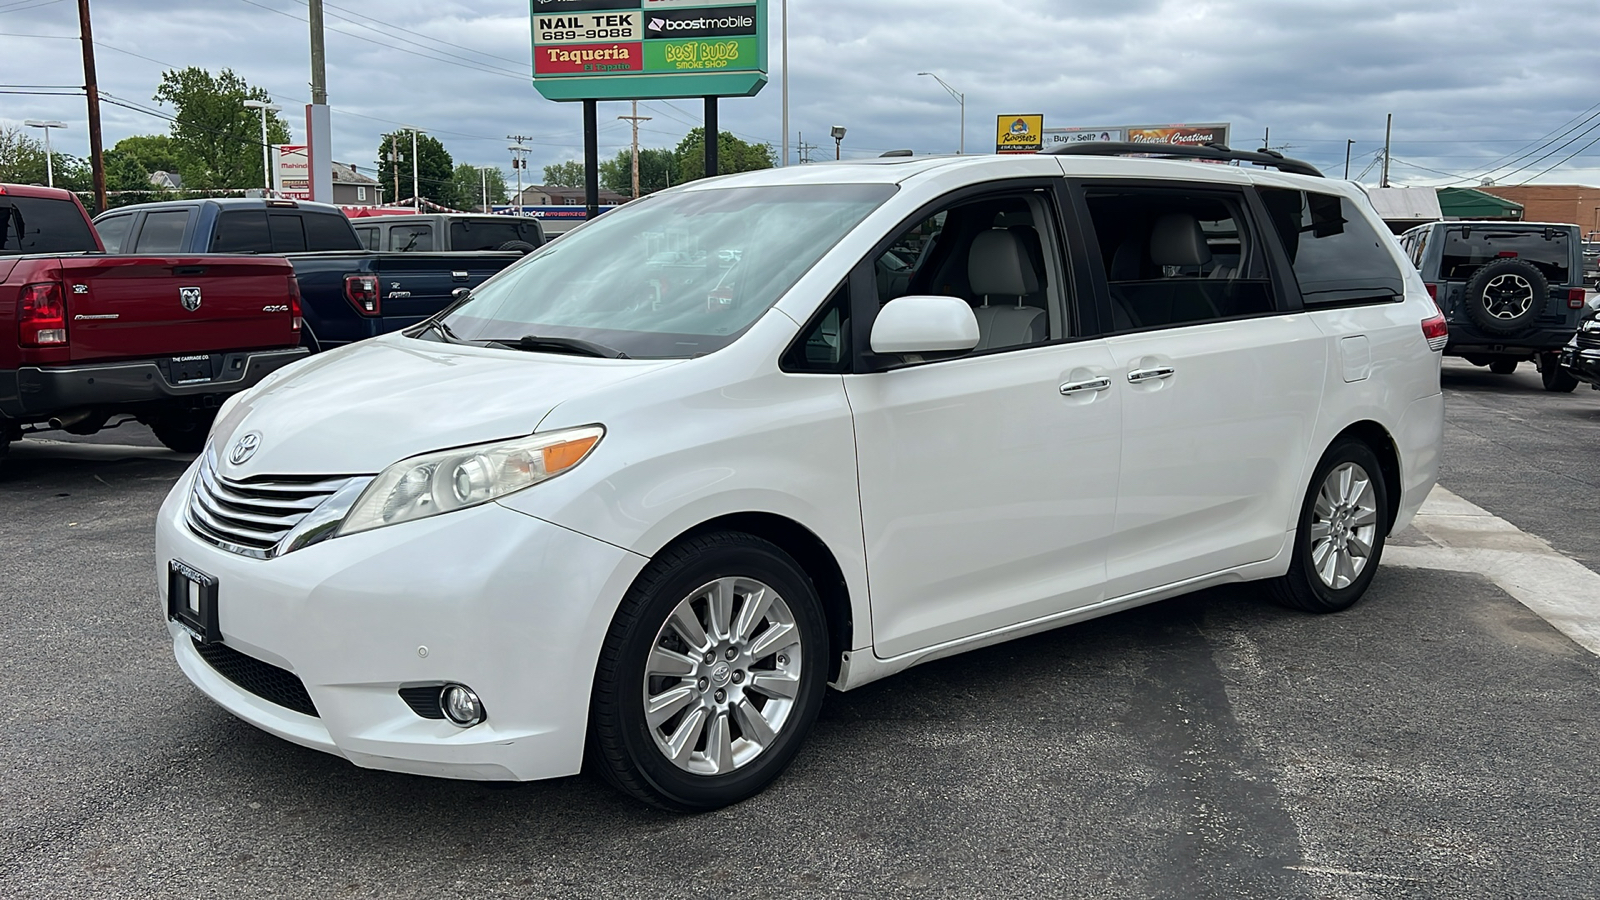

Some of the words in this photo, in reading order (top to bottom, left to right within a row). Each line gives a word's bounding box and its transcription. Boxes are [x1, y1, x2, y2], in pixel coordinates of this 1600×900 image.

[540, 17, 584, 29] NAIL
[592, 14, 633, 27] TEK
[666, 16, 753, 30] boostmobile
[542, 28, 632, 40] 689-9088
[676, 61, 703, 69] SMOKE
[705, 60, 728, 68] SHOP
[1053, 135, 1070, 143] Buy
[1077, 133, 1096, 141] Sell?
[1133, 134, 1170, 144] Natural
[1170, 132, 1213, 145] Creations
